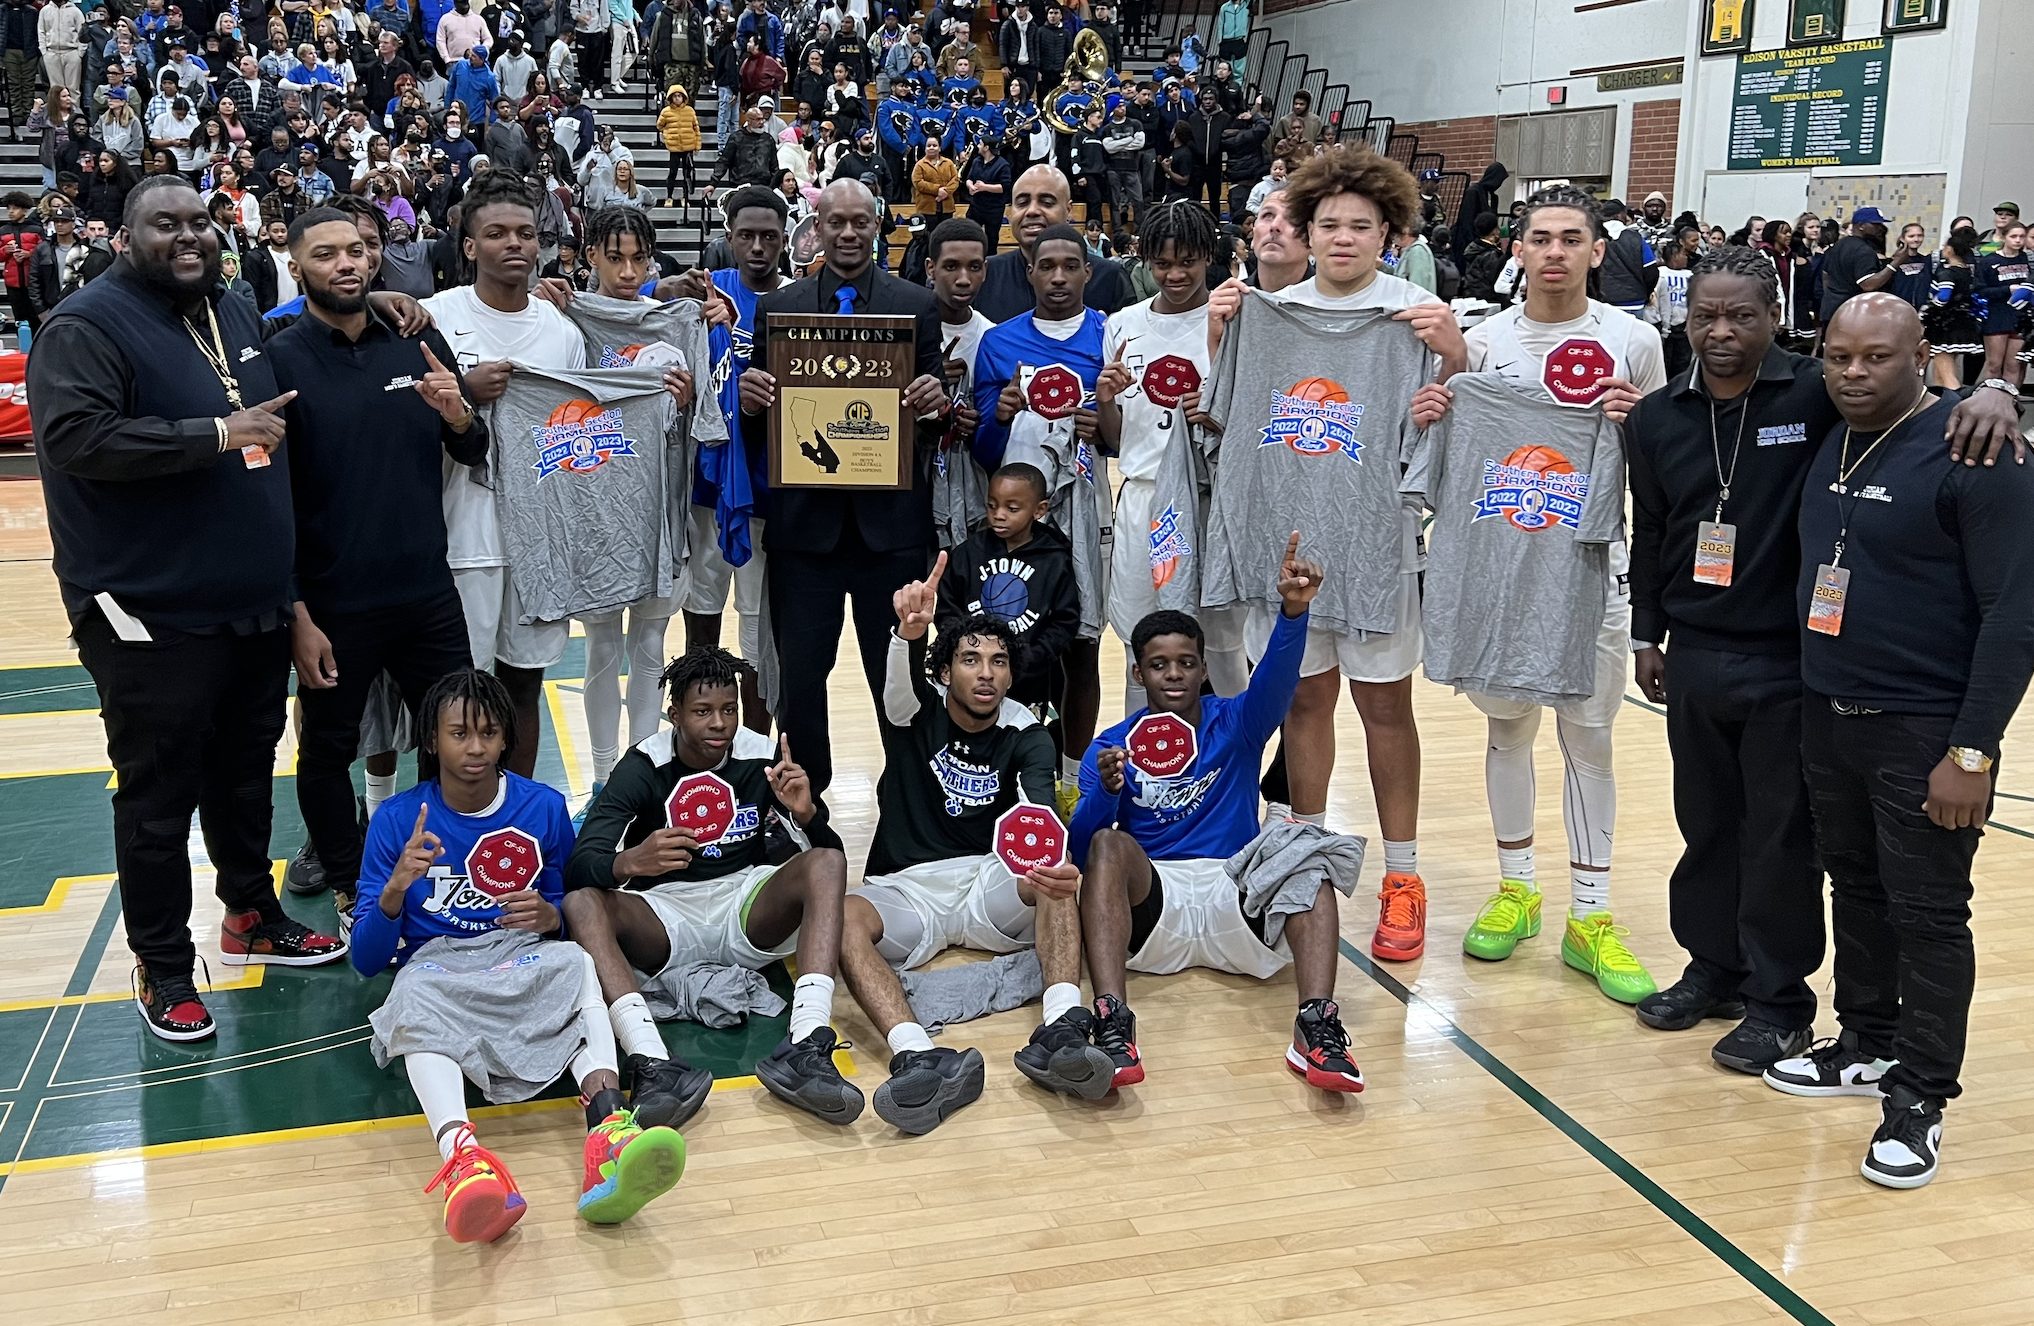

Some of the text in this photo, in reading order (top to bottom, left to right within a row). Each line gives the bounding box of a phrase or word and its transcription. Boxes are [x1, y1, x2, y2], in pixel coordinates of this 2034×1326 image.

[1742, 39, 1885, 63] EDISON VARSITY BASKETBALL
[1784, 55, 1836, 68] TEAM RECORD
[1604, 68, 1658, 89] CHARGER
[1770, 89, 1843, 103] INDIVIDUAL RECORD
[1760, 156, 1841, 167] WOMEN'S BASKETBALL
[788, 328, 895, 342] CHAMPIONS
[1567, 348, 1594, 356] CIF-SS
[789, 357, 893, 378] 20 23
[1165, 361, 1187, 373] CIF-SS
[1551, 364, 1604, 375] 20 23
[1040, 373, 1061, 383] CIF-SS
[1149, 372, 1192, 389] 20 23
[1033, 385, 1073, 400] 20 23
[848, 403, 870, 420] CIF
[1272, 390, 1364, 415] Southern Section
[531, 408, 622, 437] Southern Section
[1270, 405, 1360, 427] CHAMPIONS
[535, 420, 623, 448] CHAMPIONS
[827, 431, 889, 440] CHAMPIONSHIPS
[1273, 421, 1352, 443] 2022 2023
[1302, 419, 1325, 438] CIF
[1757, 423, 1806, 438] JORDAN
[544, 436, 621, 462] 2022 2023
[1484, 459, 1540, 479] Southern
[1484, 475, 1588, 497] CHAMPIONS
[1489, 492, 1579, 515] 2022 2023
[1522, 492, 1543, 513] CIF
[978, 557, 1035, 582] J-TOWN
[1146, 724, 1170, 733] CIF-SS
[1137, 737, 1185, 752] 20 23
[1142, 752, 1185, 769] CHAMPIONS
[679, 784, 720, 805] CHAMPIONS
[680, 801, 727, 821] 20 23
[1020, 815, 1045, 826] CIF-SS
[503, 839, 527, 854] CIF-SS
[1004, 832, 1055, 847] 20 23
[481, 849, 527, 876] 20 23
[1006, 848, 1051, 868] CHAMPIONS
[477, 864, 516, 889] CHAMPIONS
